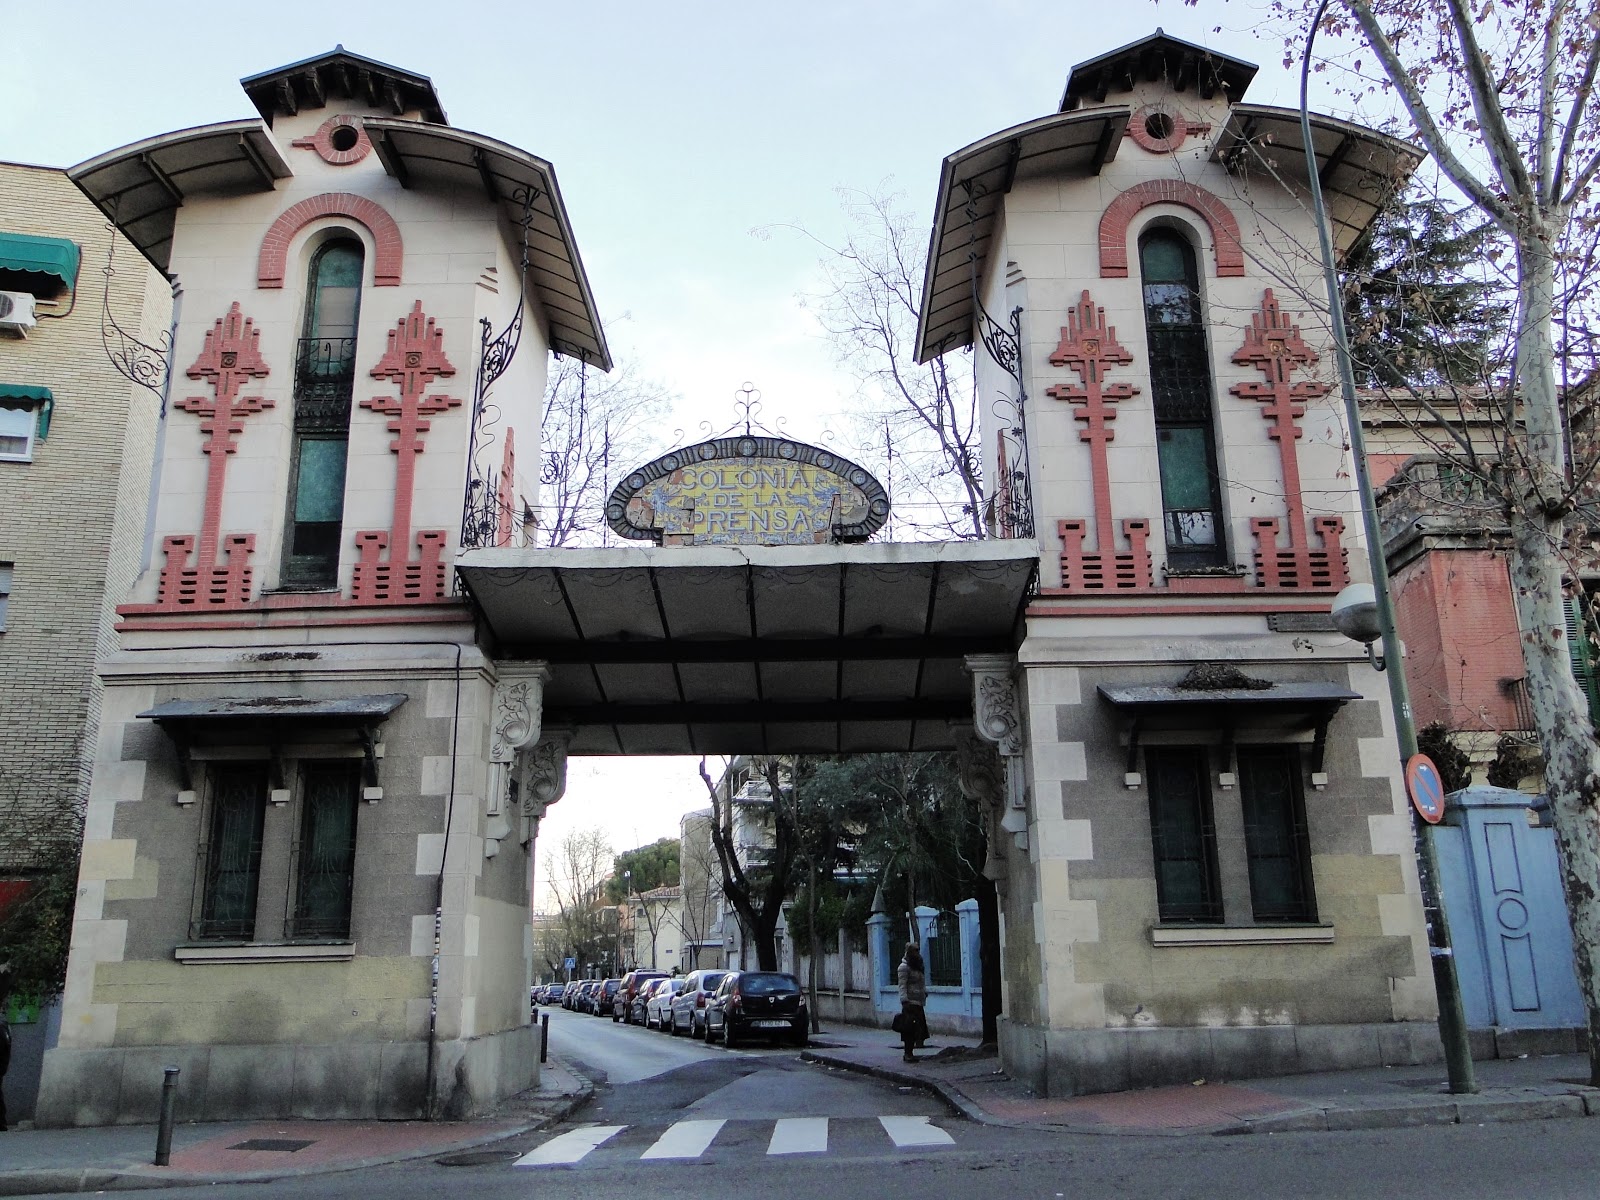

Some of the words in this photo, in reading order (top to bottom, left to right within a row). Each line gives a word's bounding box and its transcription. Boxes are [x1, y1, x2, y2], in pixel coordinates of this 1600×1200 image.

[681, 468, 809, 490] COLONIA
[714, 493, 743, 507] DE
[754, 493, 782, 507] LA
